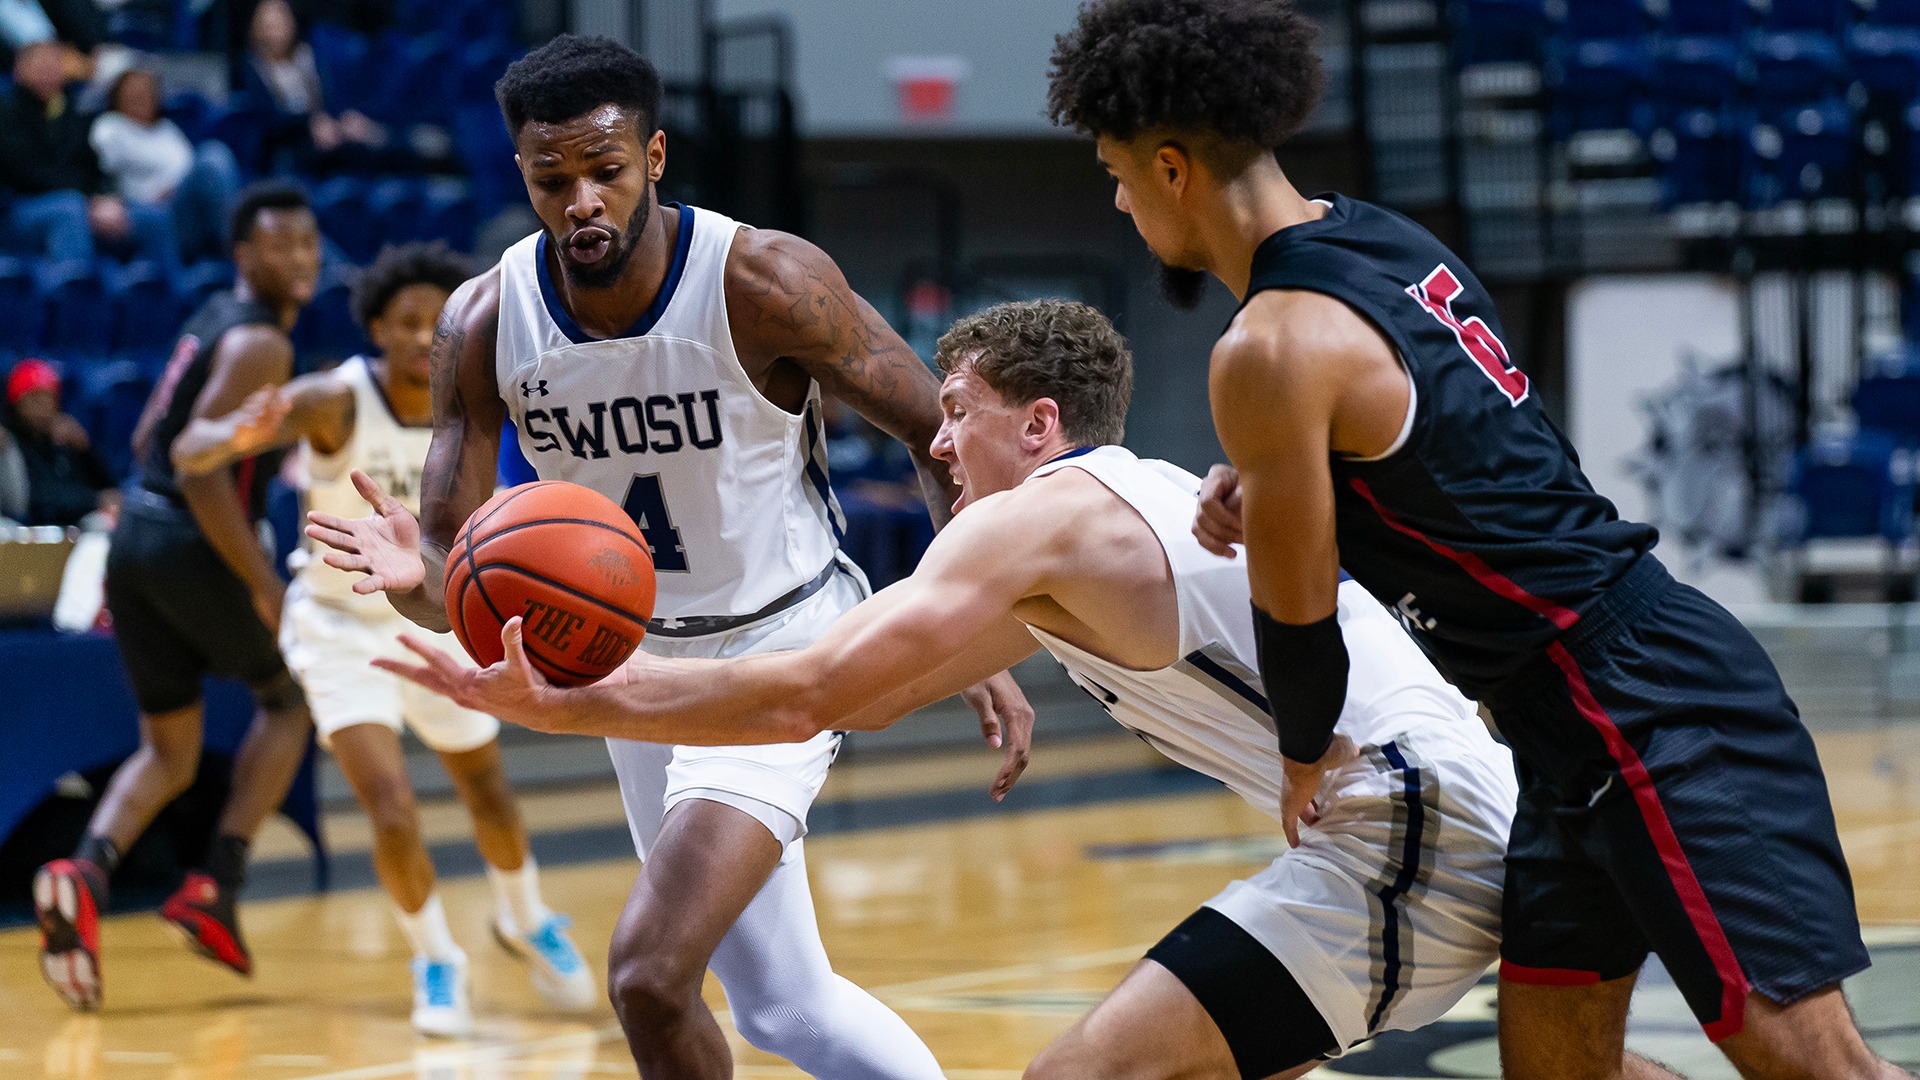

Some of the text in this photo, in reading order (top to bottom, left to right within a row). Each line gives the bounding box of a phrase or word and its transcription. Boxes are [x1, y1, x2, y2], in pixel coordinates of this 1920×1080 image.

[524, 388, 724, 461] SWOSU
[620, 471, 691, 574] 4
[522, 598, 586, 652] THE
